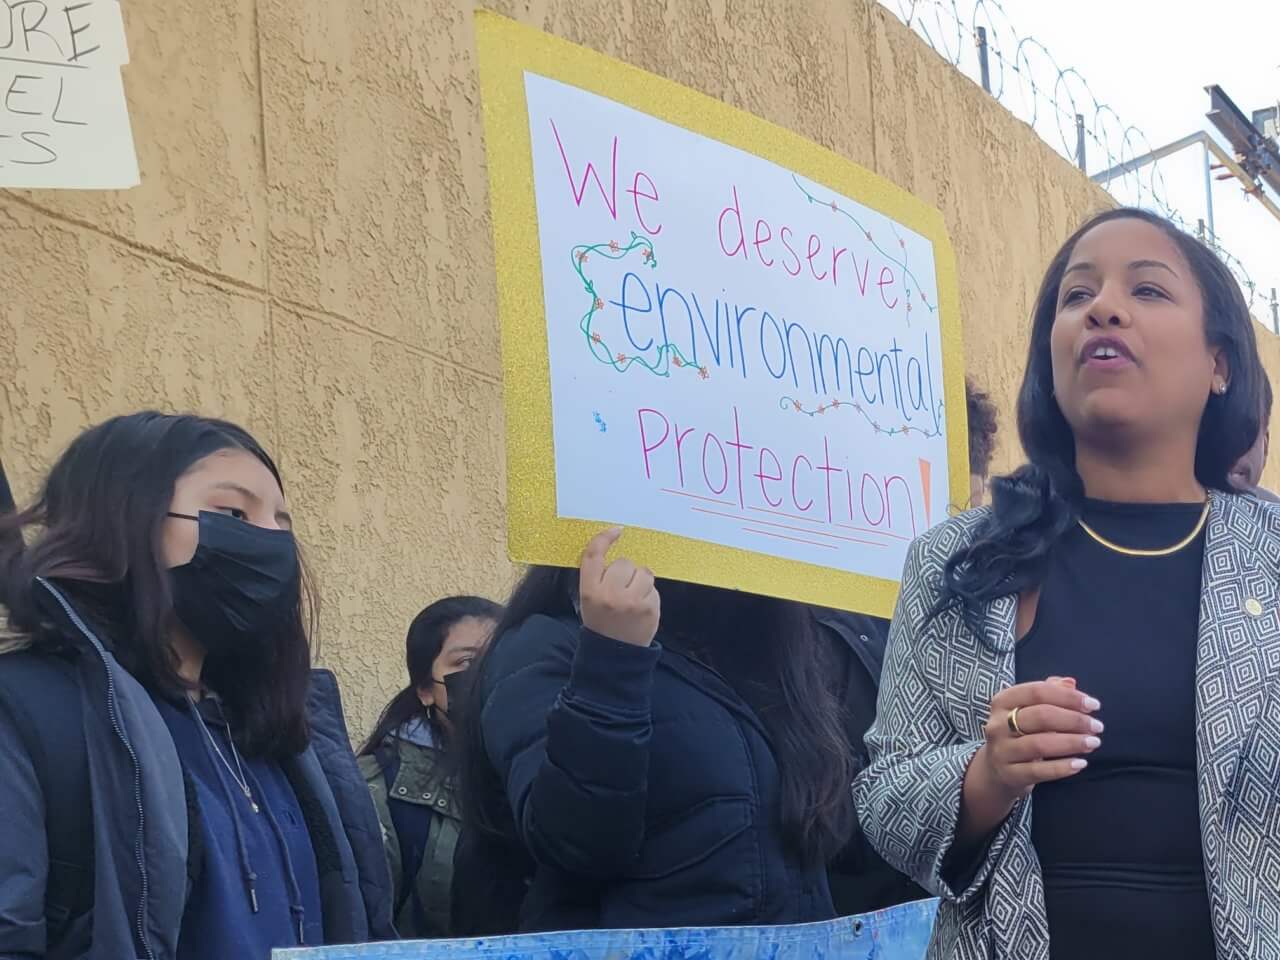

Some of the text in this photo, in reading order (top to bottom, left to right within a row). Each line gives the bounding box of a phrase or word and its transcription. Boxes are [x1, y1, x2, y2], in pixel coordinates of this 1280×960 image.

[549, 117, 898, 309] We deserve
[609, 271, 941, 430] environmental
